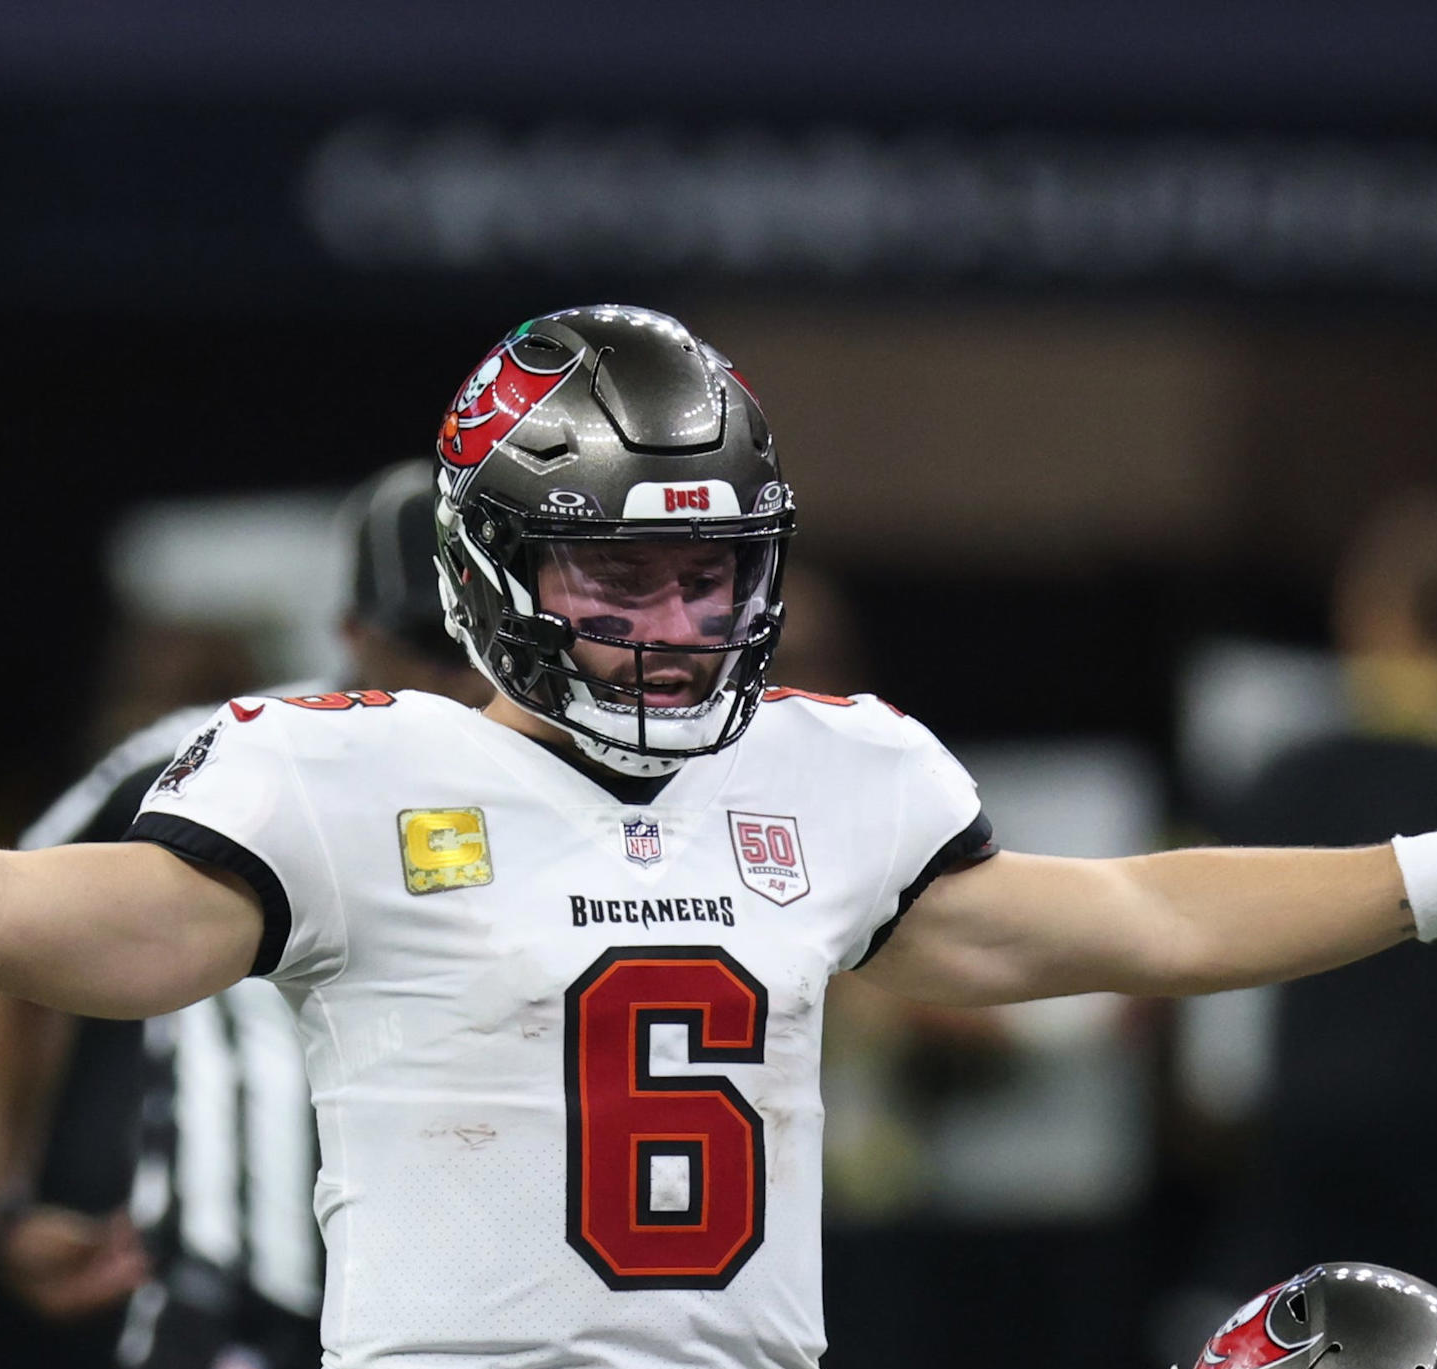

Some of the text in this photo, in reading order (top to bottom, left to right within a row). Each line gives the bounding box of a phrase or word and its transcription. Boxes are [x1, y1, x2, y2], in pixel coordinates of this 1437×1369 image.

[540, 503, 594, 517] OAKLEY
[663, 486, 710, 513] BUCS
[406, 812, 484, 870] C
[629, 838, 659, 858] NFL
[737, 821, 796, 867] 50
[567, 895, 735, 930] BUCCANEERS
[564, 946, 767, 1291] 6
